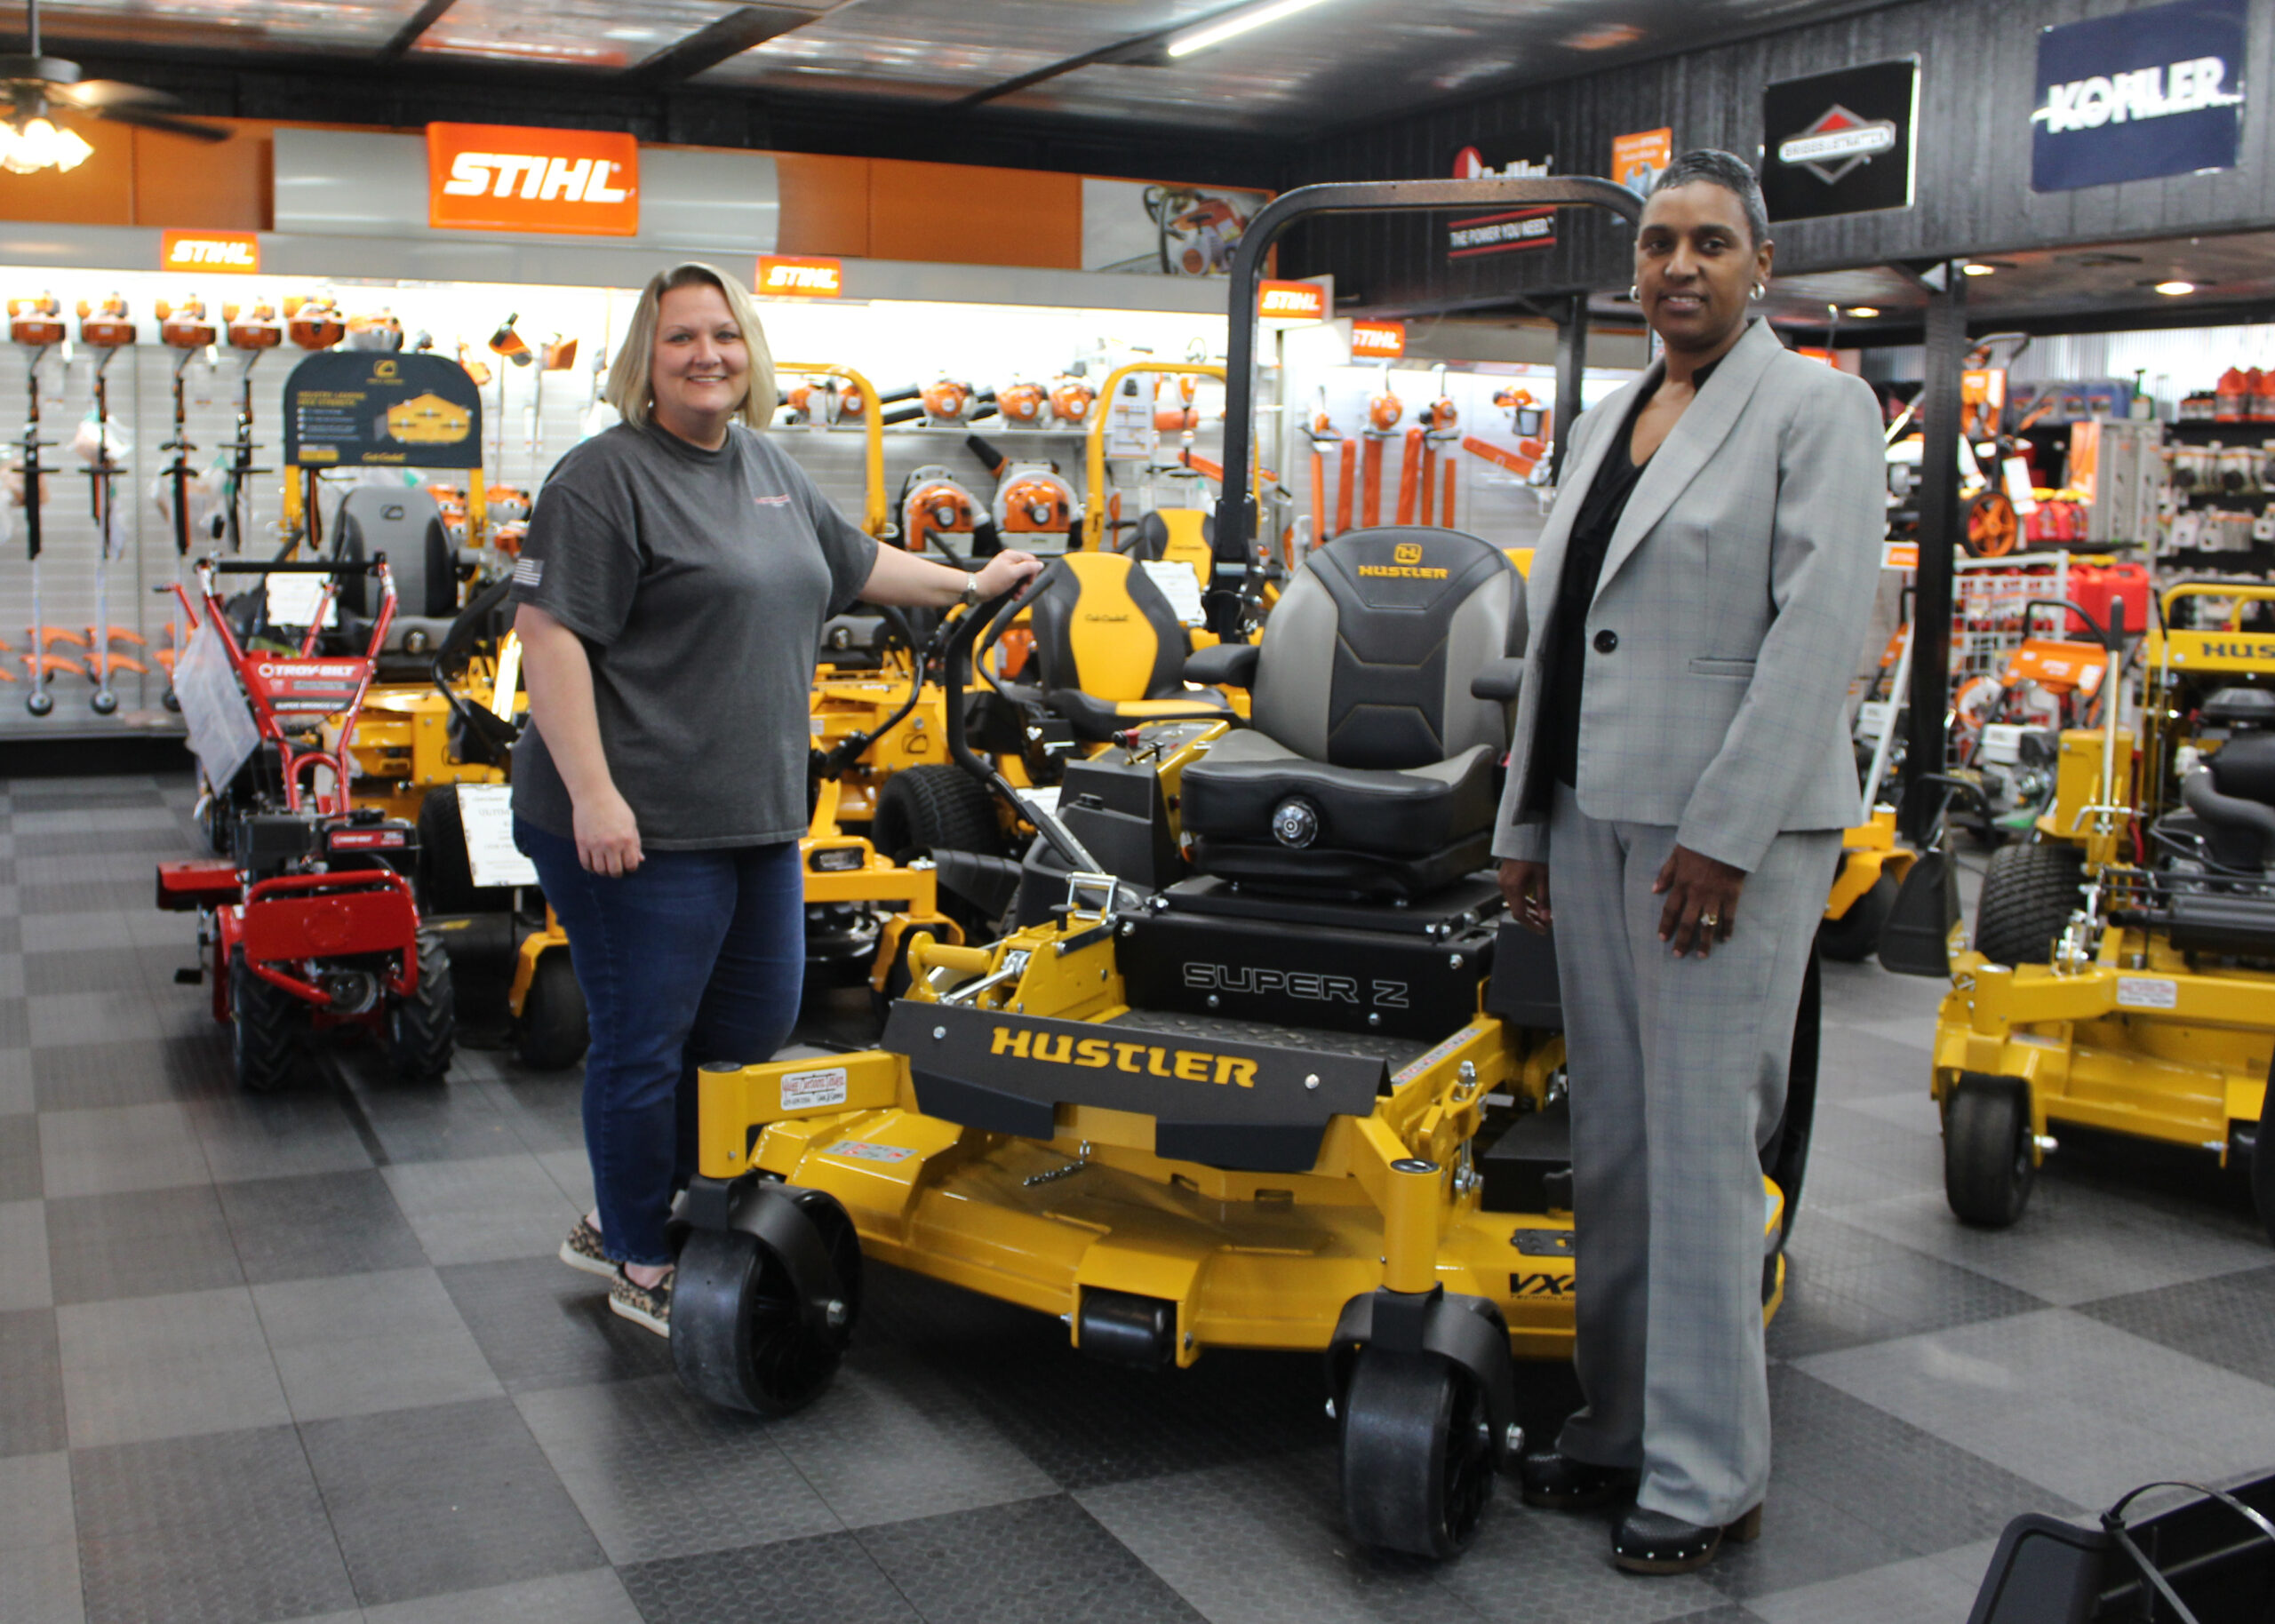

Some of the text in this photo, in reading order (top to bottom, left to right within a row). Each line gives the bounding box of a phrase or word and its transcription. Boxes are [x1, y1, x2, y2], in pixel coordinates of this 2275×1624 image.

[2045, 55, 2227, 134] KOHLER
[443, 152, 626, 203] STIHL
[1449, 231, 1468, 247] THE
[1469, 225, 1500, 244] POWER
[1501, 222, 1521, 240] YOU
[171, 239, 254, 265] STIHL
[768, 265, 838, 289] STIHL
[1262, 291, 1321, 310] STIHL
[1358, 565, 1449, 580] HUSTLER
[275, 665, 355, 676] TROY-BILT
[1183, 962, 1409, 1008] SUPER Z
[990, 1026, 1258, 1088] HUSTLER
[1509, 1272, 1576, 1295] VX
